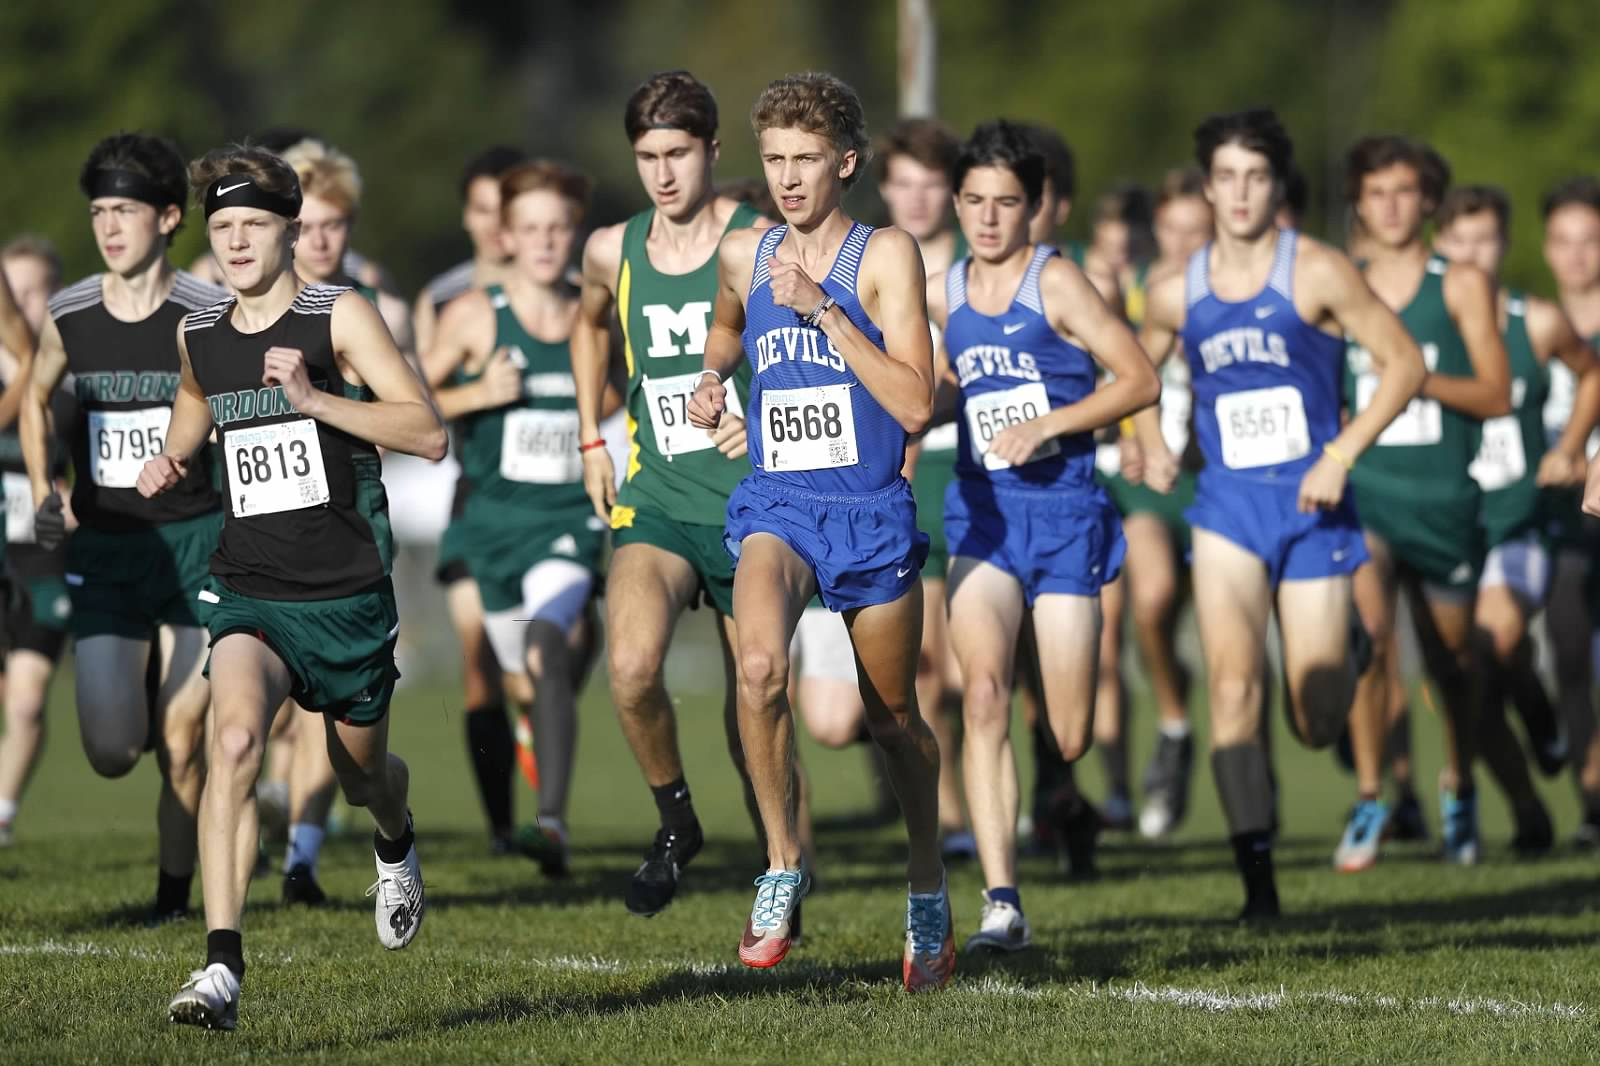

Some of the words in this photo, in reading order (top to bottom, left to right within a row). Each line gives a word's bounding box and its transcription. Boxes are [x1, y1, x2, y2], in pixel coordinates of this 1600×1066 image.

[642, 302, 712, 358] M
[756, 327, 846, 375] DEVILS
[1198, 326, 1291, 374] DEVILS
[955, 344, 1042, 388] DEVILS
[97, 425, 164, 461] 6795
[769, 402, 843, 443] 6568
[1229, 401, 1291, 440] 6567
[236, 439, 311, 486] 6813
